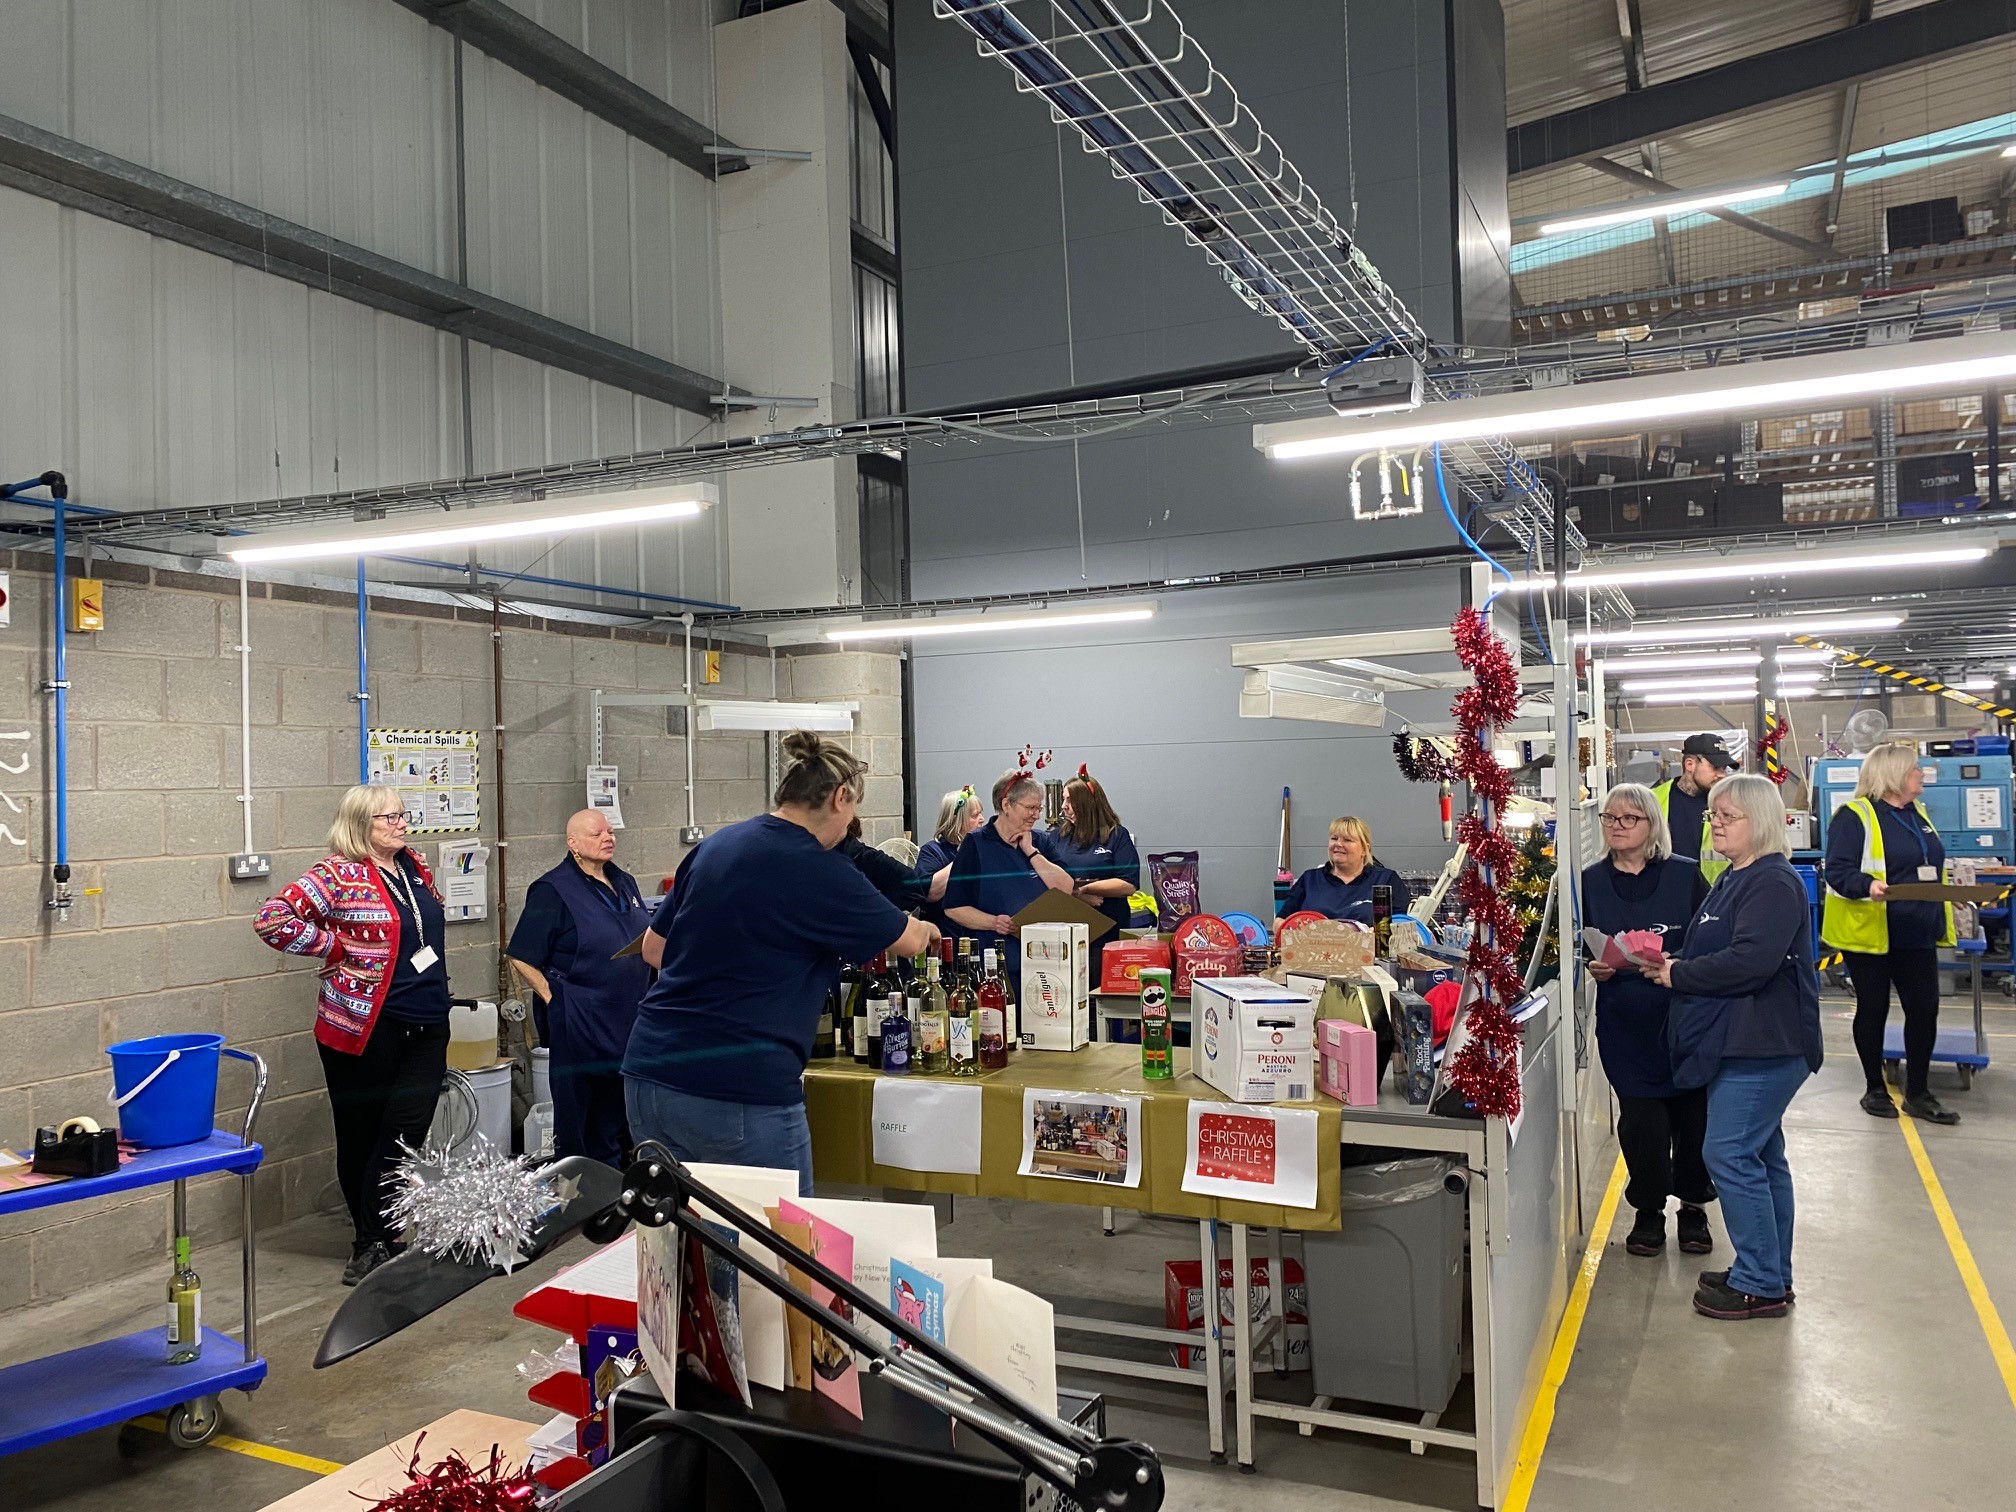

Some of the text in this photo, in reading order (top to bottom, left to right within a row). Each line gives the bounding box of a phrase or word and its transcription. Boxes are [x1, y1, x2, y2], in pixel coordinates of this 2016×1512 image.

[386, 734, 461, 746] Chemical Spills
[1162, 880, 1191, 891] Quality
[1166, 889, 1190, 898] Street
[1185, 958, 1227, 979] Galup
[1142, 1004, 1167, 1017] PRINGLES
[1257, 1053, 1296, 1064] PERONI
[1423, 1036, 1431, 1073] Painting
[880, 1122, 907, 1133] RAFFLE
[1199, 1128, 1274, 1149] CHRISTMAS
[1212, 1145, 1261, 1165] RAFFLE
[854, 1263, 888, 1272] Christmas
[864, 1274, 880, 1282] New
[1289, 1288, 1299, 1300] 24
[925, 1287, 933, 1330] merry
